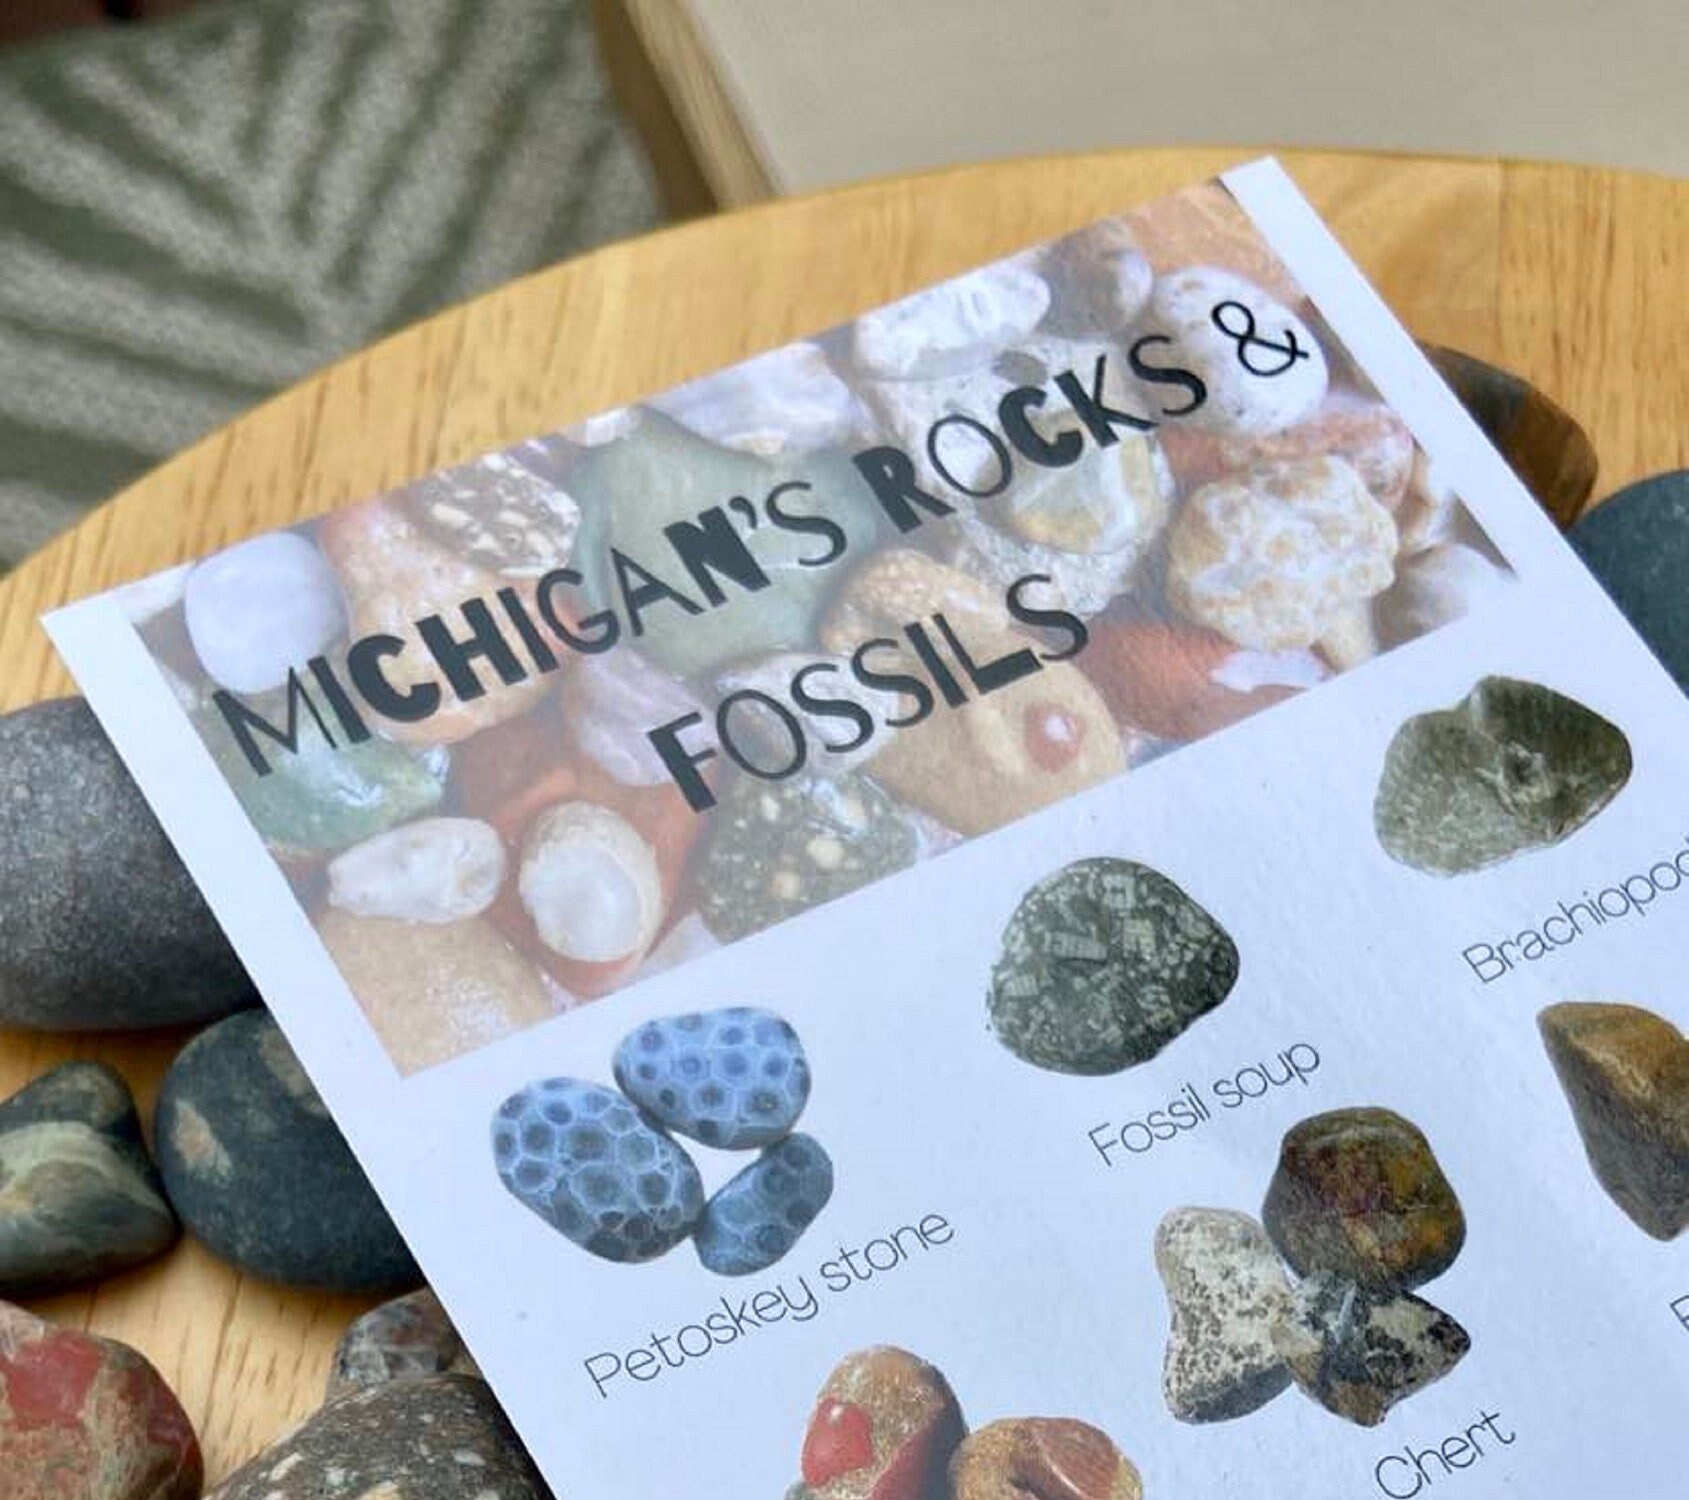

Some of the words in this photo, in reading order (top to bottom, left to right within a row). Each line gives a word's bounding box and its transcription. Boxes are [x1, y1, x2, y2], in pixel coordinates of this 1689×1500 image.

[211, 480, 848, 777] MICHIGAN'S
[853, 333, 1208, 535] ROCKS
[1210, 300, 1309, 378] &
[646, 573, 1089, 813] FOSSILS
[1088, 1085, 1211, 1167] Fossil
[1213, 1041, 1321, 1110] soup
[583, 1276, 820, 1398] Petoskey
[819, 1211, 955, 1294] stone
[1375, 1410, 1517, 1500] Chert
